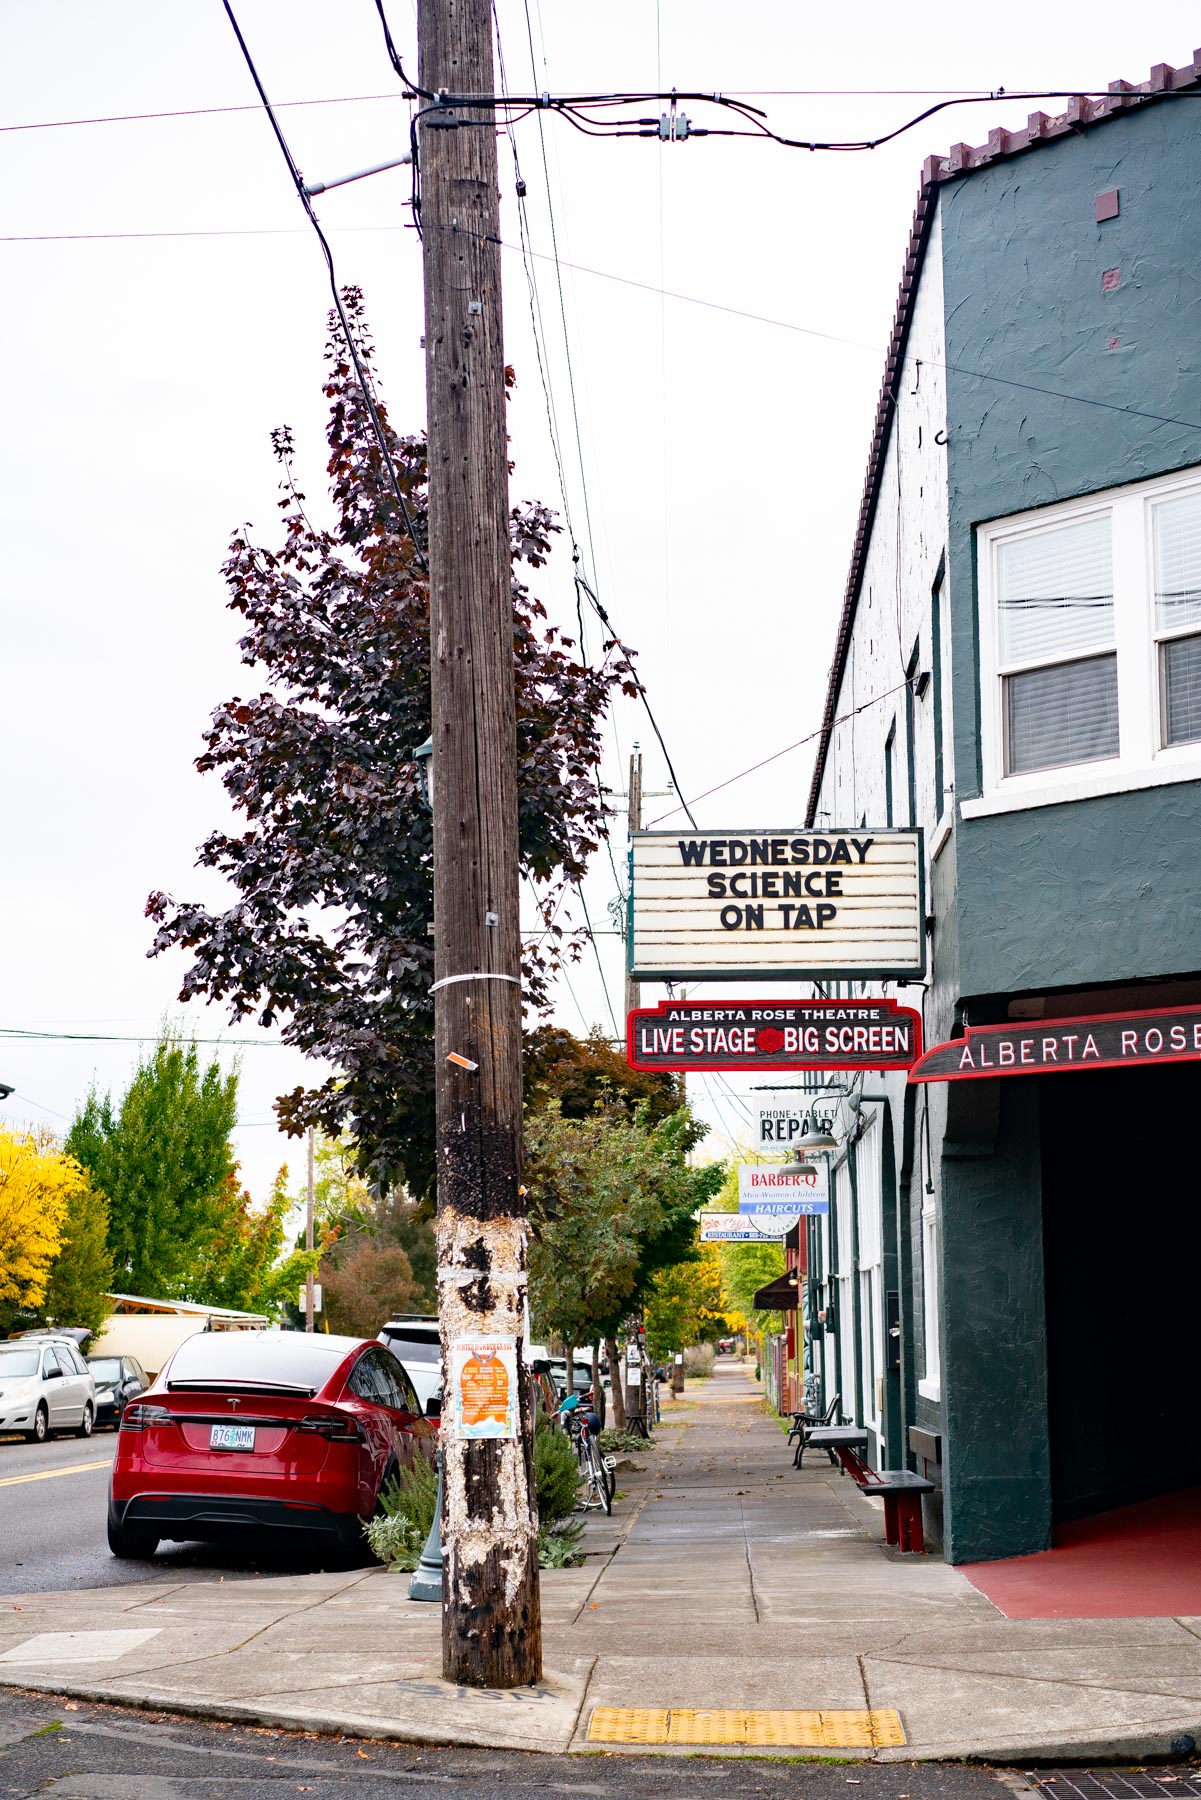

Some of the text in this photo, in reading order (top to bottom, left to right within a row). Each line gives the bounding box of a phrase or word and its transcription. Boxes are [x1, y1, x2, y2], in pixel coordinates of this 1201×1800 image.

[678, 838, 874, 866] WEDNESDAY
[707, 871, 843, 898] SCIENCE
[720, 903, 837, 930] ON TAP
[668, 1009, 880, 1021] ALBERTA ROSE THEATRE
[641, 1025, 909, 1054] LIVE STAGE BIG SCREEN
[959, 1034, 1100, 1069] ALBERTA
[760, 1119, 833, 1142] REPAR
[751, 1173, 817, 1188] BARBER-Q
[755, 1204, 814, 1213] HAIRCUTS
[213, 1430, 253, 1442] 876 NMK
